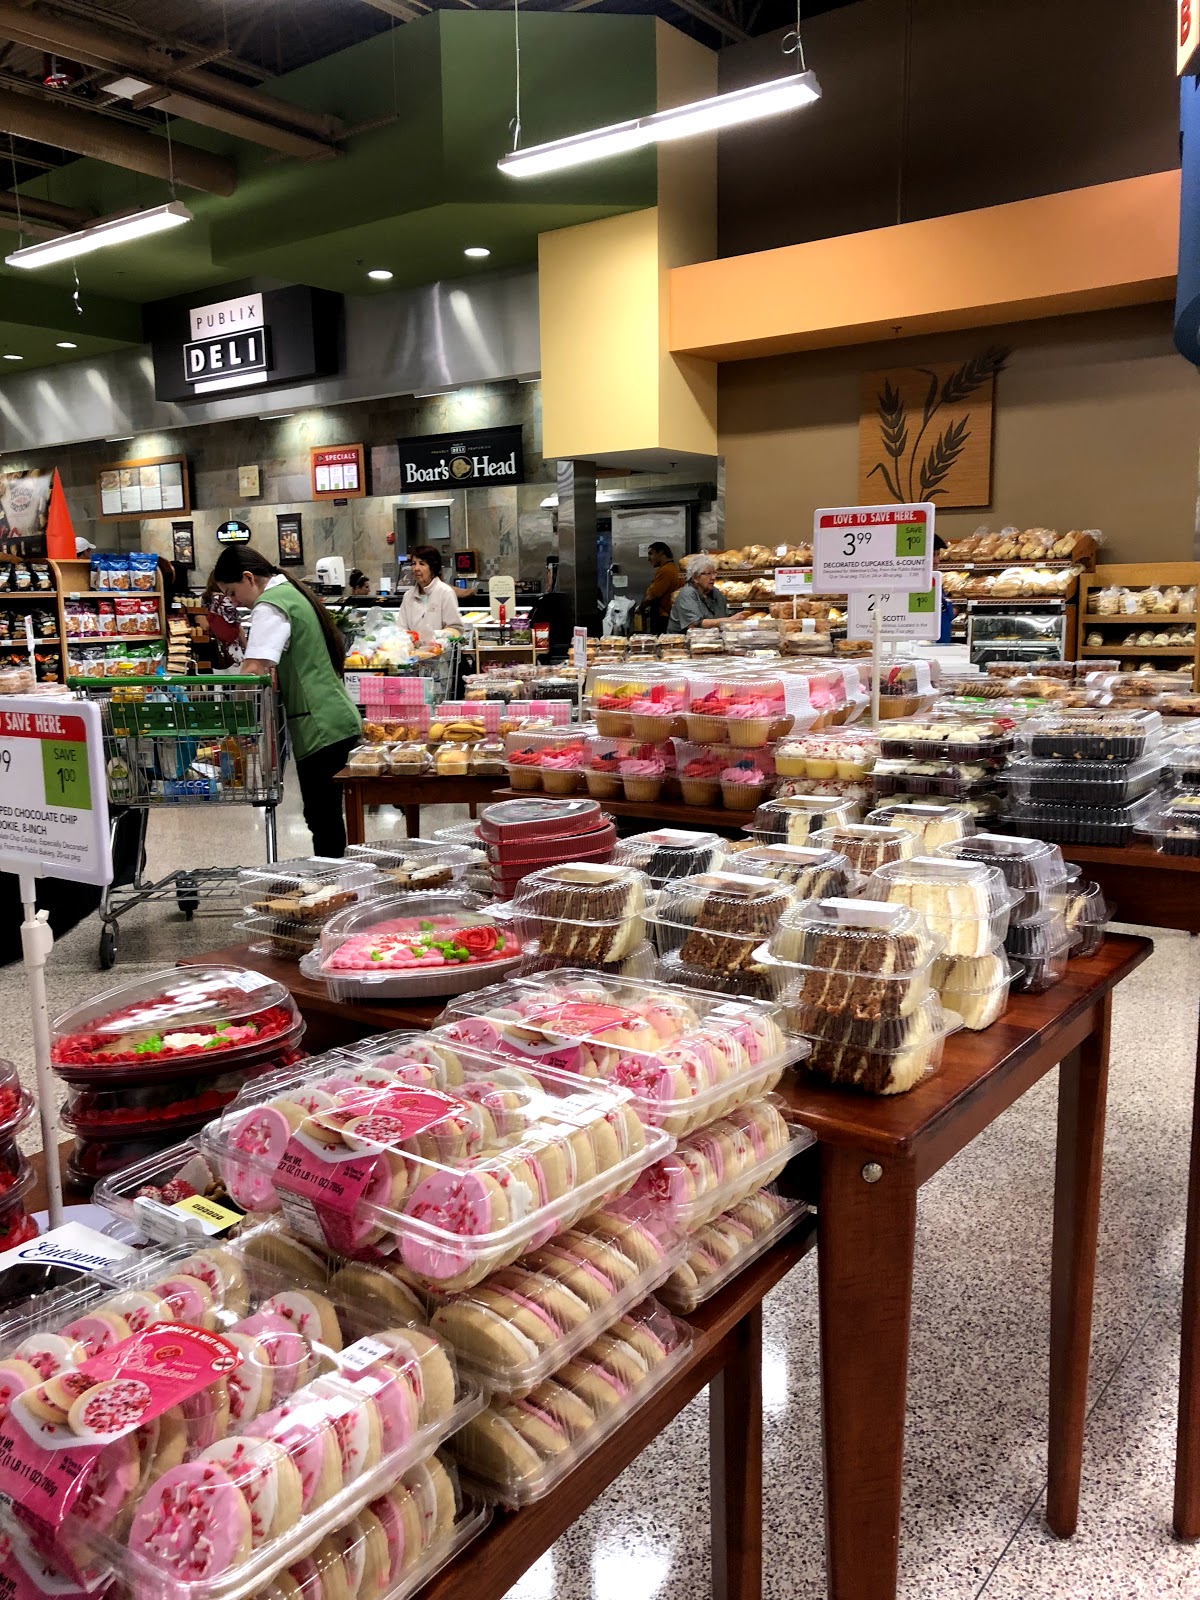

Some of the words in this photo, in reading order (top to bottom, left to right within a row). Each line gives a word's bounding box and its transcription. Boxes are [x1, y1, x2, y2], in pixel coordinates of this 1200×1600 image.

[196, 304, 255, 329] PUBLIX
[190, 337, 256, 373] DELI
[324, 452, 356, 461] SPECIALS
[405, 459, 450, 483] Boar's
[471, 451, 516, 478] Head
[833, 514, 853, 525] LOVE
[856, 513, 867, 524] TO
[870, 512, 890, 523] SAVE
[894, 510, 917, 522] HERE.
[906, 526, 922, 534] SAVE
[823, 561, 860, 569] DECORATED
[5, 712, 31, 732] SAVE
[34, 714, 66, 735] HERE.
[54, 748, 77, 762] SAVE
[175, 780, 210, 789] ZICO
[14, 808, 58, 823] CHOCOLATE
[60, 813, 78, 825] CHIP
[22, 823, 48, 835] 8-INCH
[62, 841, 89, 852] Decorated
[277, 1161, 288, 1170] 27
[286, 1164, 296, 1175] OZ
[301, 1170, 312, 1180] LB
[309, 1174, 319, 1183] 11
[318, 1177, 330, 1190] OZ)
[153, 1323, 194, 1336] PEANUT
[198, 1333, 217, 1345] NUT
[213, 1342, 232, 1355] FREE
[10, 1458, 22, 1472] LB
[20, 1464, 32, 1477] 11
